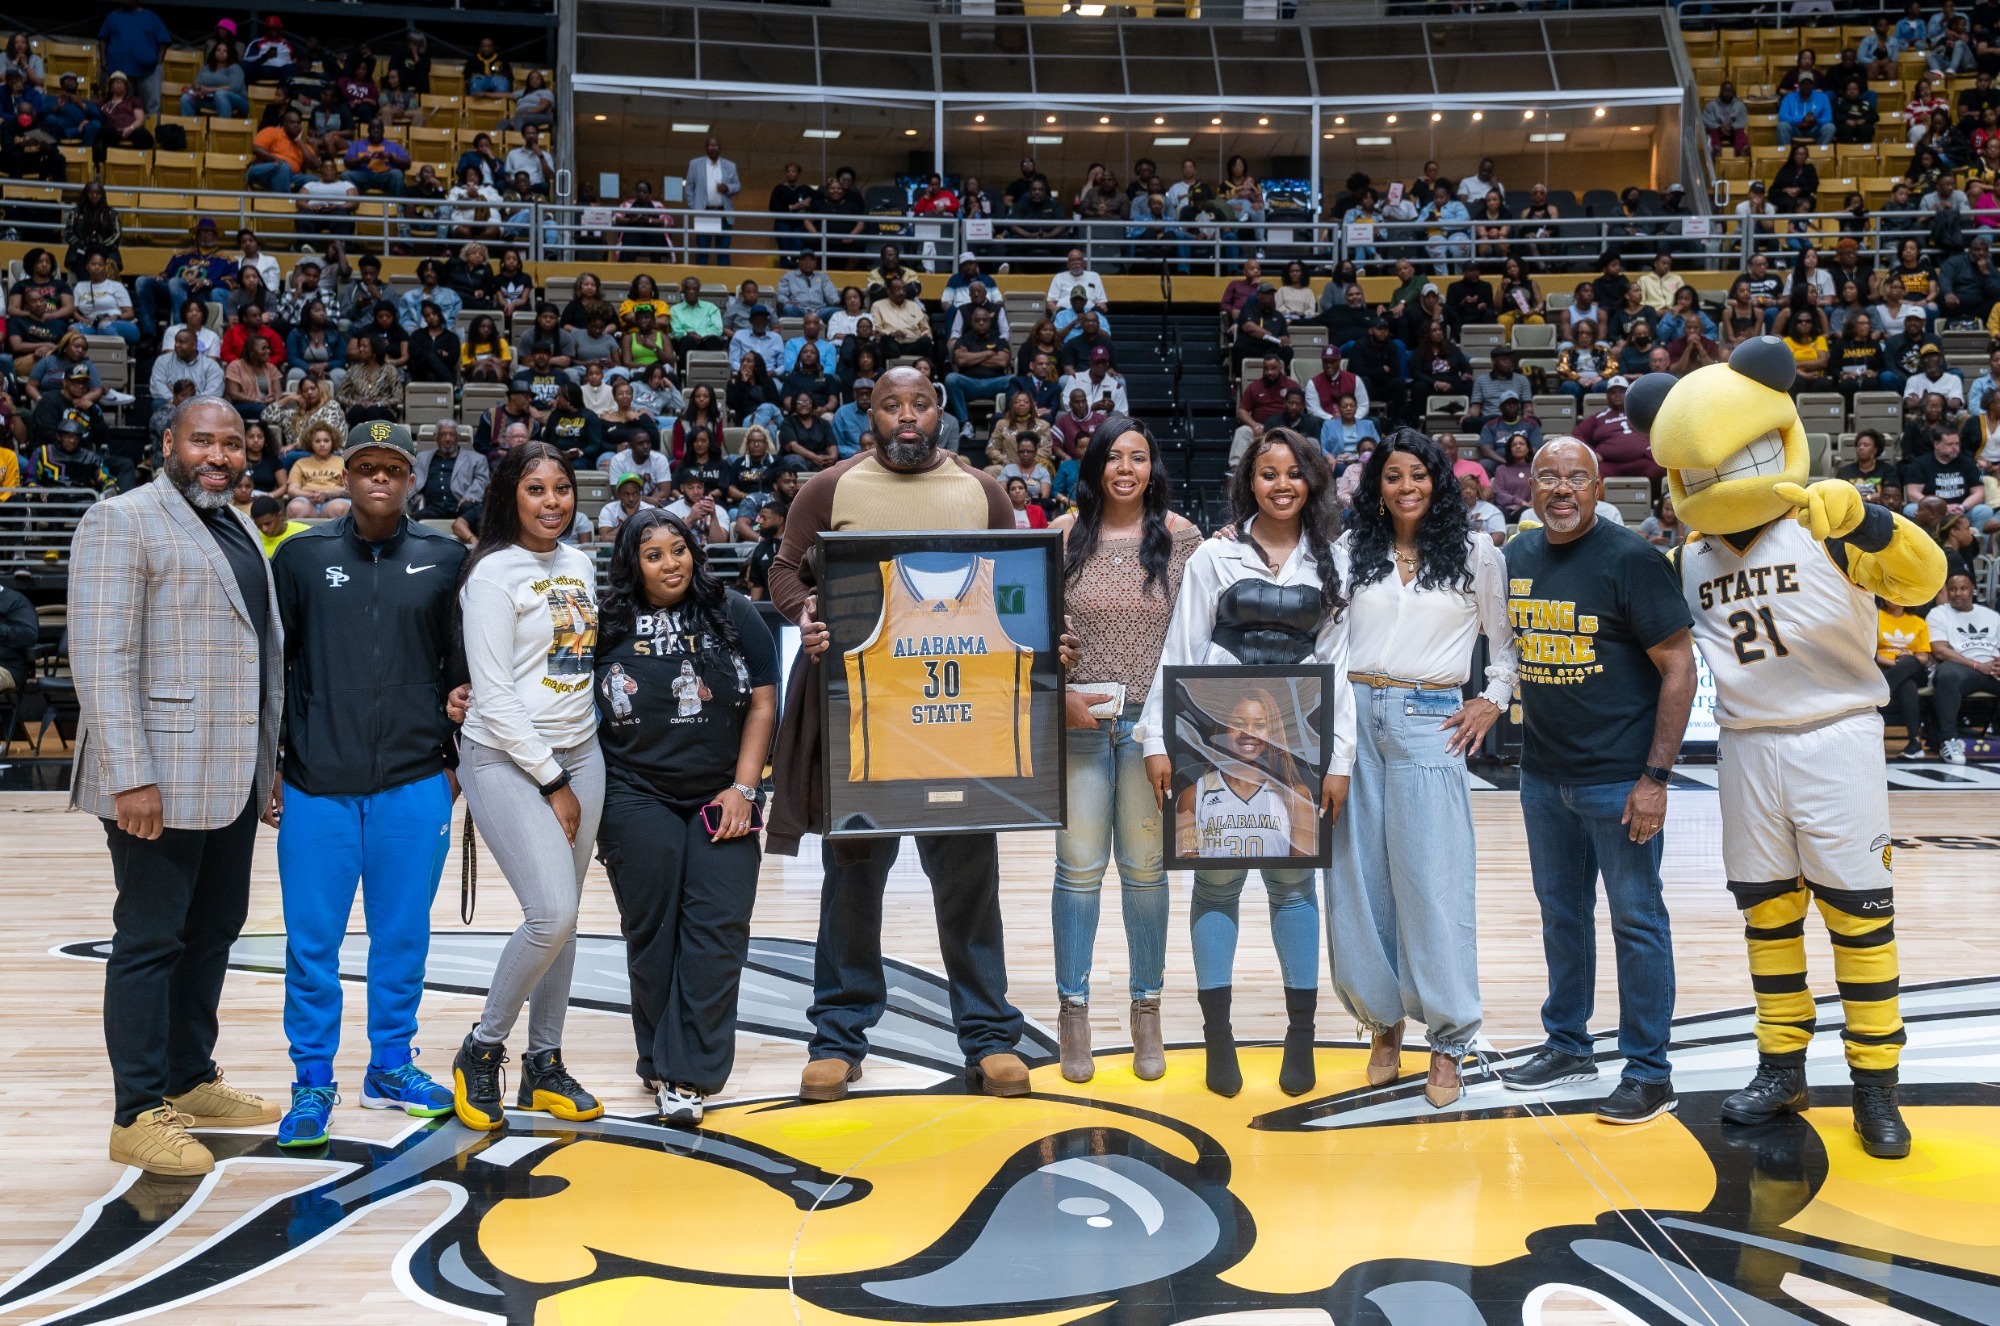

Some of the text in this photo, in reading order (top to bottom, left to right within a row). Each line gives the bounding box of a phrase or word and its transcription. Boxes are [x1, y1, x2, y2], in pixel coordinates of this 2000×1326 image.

[1620, 420, 1633, 435] 1
[325, 565, 350, 587] SP
[1510, 579, 1533, 596] THE
[1698, 563, 1801, 612] STATE
[1508, 598, 1599, 634] STING IS
[893, 634, 988, 658] ALABAMA
[1727, 605, 1790, 667] 21
[1522, 632, 1596, 665] HERE
[922, 659, 960, 699] 30
[1557, 664, 1604, 677] STATE
[911, 703, 973, 725] STATE
[1182, 828, 1222, 837] ANIYAH
[1206, 814, 1282, 831] ALABAMA
[1182, 838, 1222, 848] SMITH
[1223, 835, 1264, 858] 30
